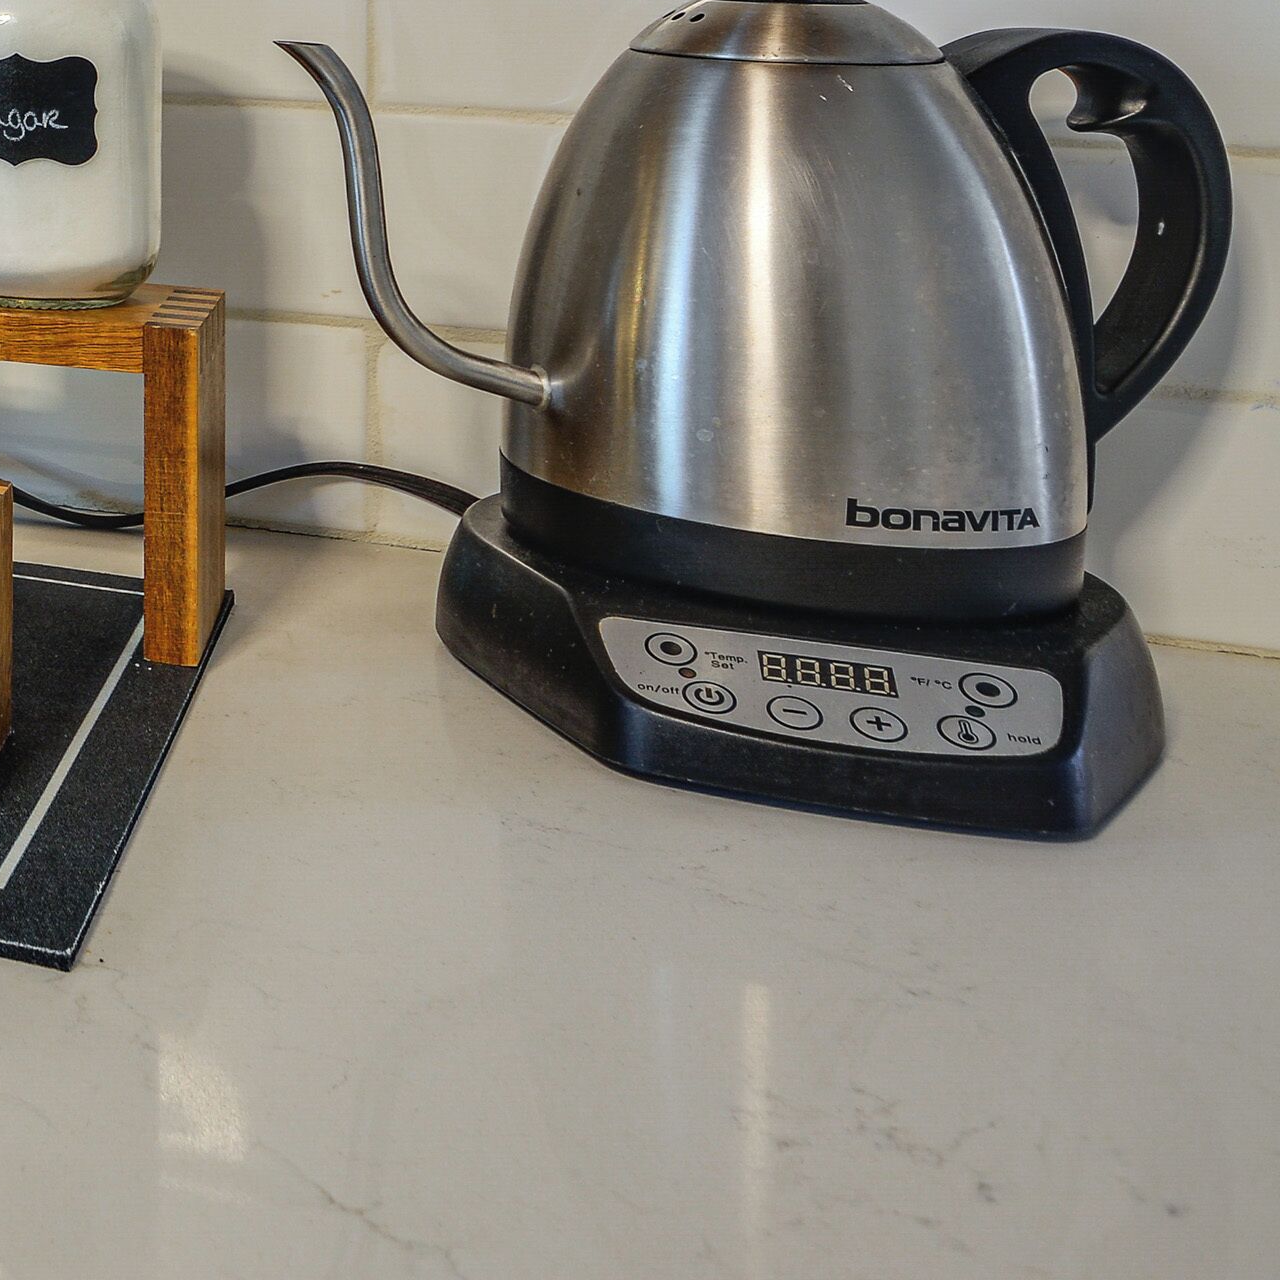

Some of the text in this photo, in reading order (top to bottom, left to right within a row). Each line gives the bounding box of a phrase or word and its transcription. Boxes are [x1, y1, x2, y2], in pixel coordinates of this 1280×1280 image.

[711, 660, 735, 670] Set
[637, 682, 680, 695] on/off
[1007, 733, 1042, 746] hold
